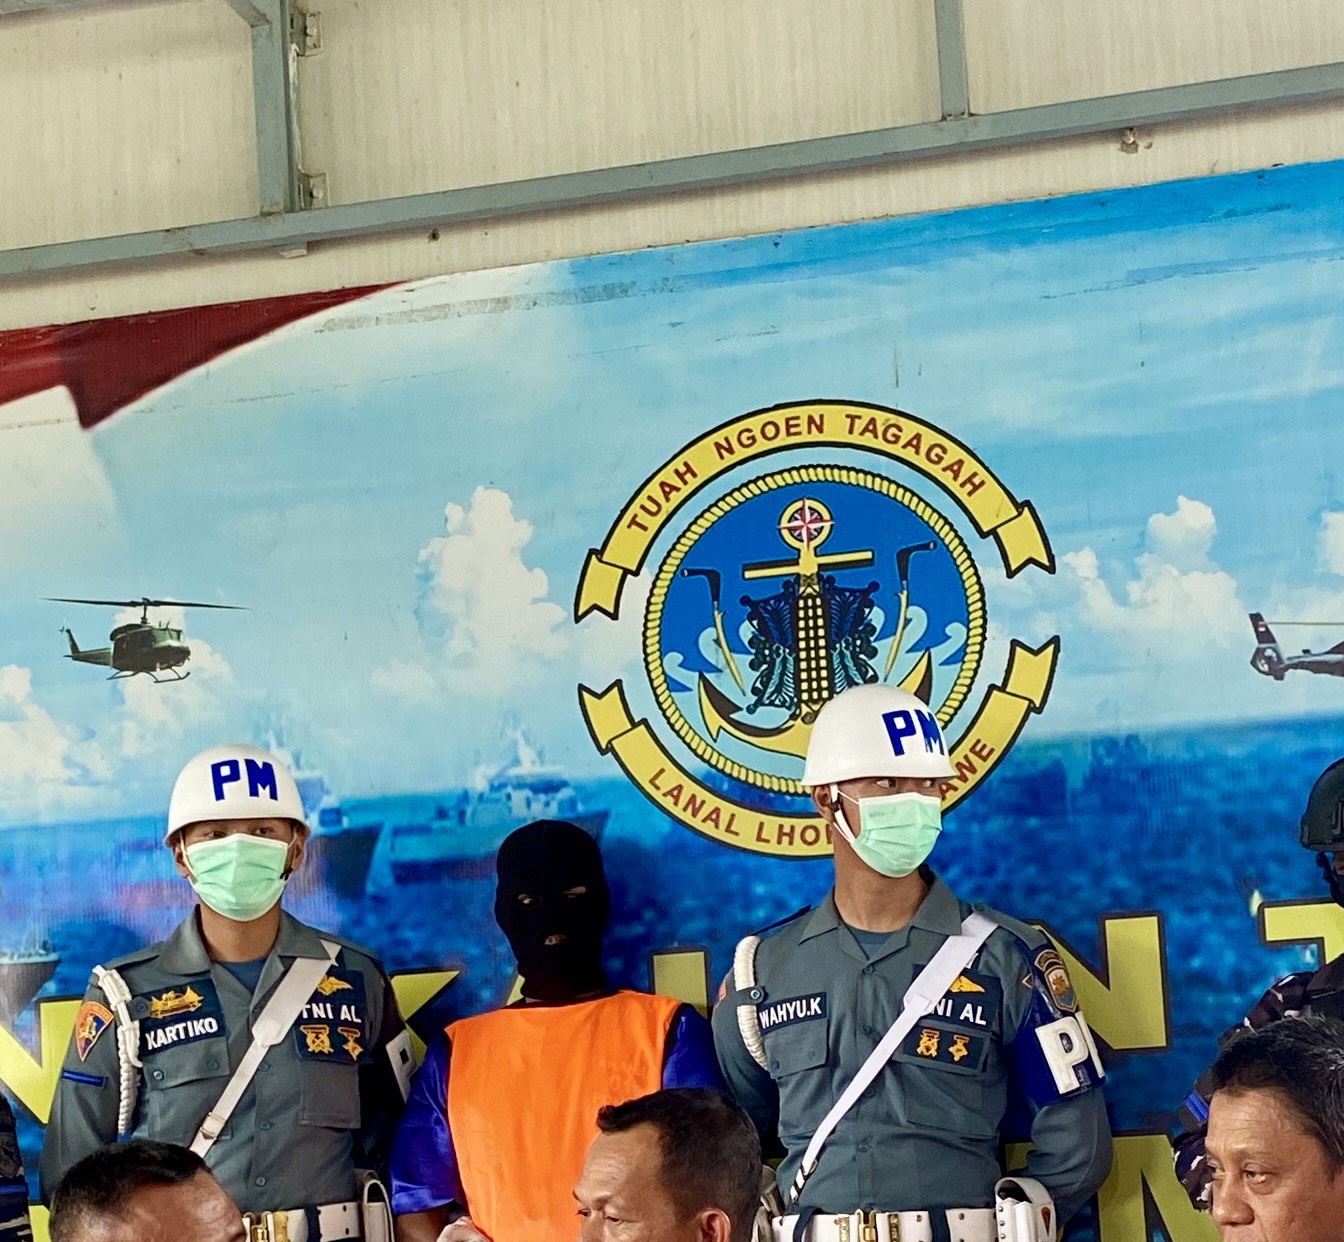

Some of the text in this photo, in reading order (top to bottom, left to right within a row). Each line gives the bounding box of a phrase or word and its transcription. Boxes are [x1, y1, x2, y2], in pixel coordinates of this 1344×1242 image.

[627, 413, 986, 538] TUAH NGOEN TAGAGAH
[882, 708, 946, 756] PM
[211, 758, 278, 801] PM
[648, 766, 740, 838] LANAL
[145, 1016, 219, 1051] KARTIKO
[340, 1003, 362, 1023] AL
[759, 997, 822, 1030] WAHYU.K
[959, 1003, 988, 1026] AL
[1035, 1011, 1106, 1095] P
